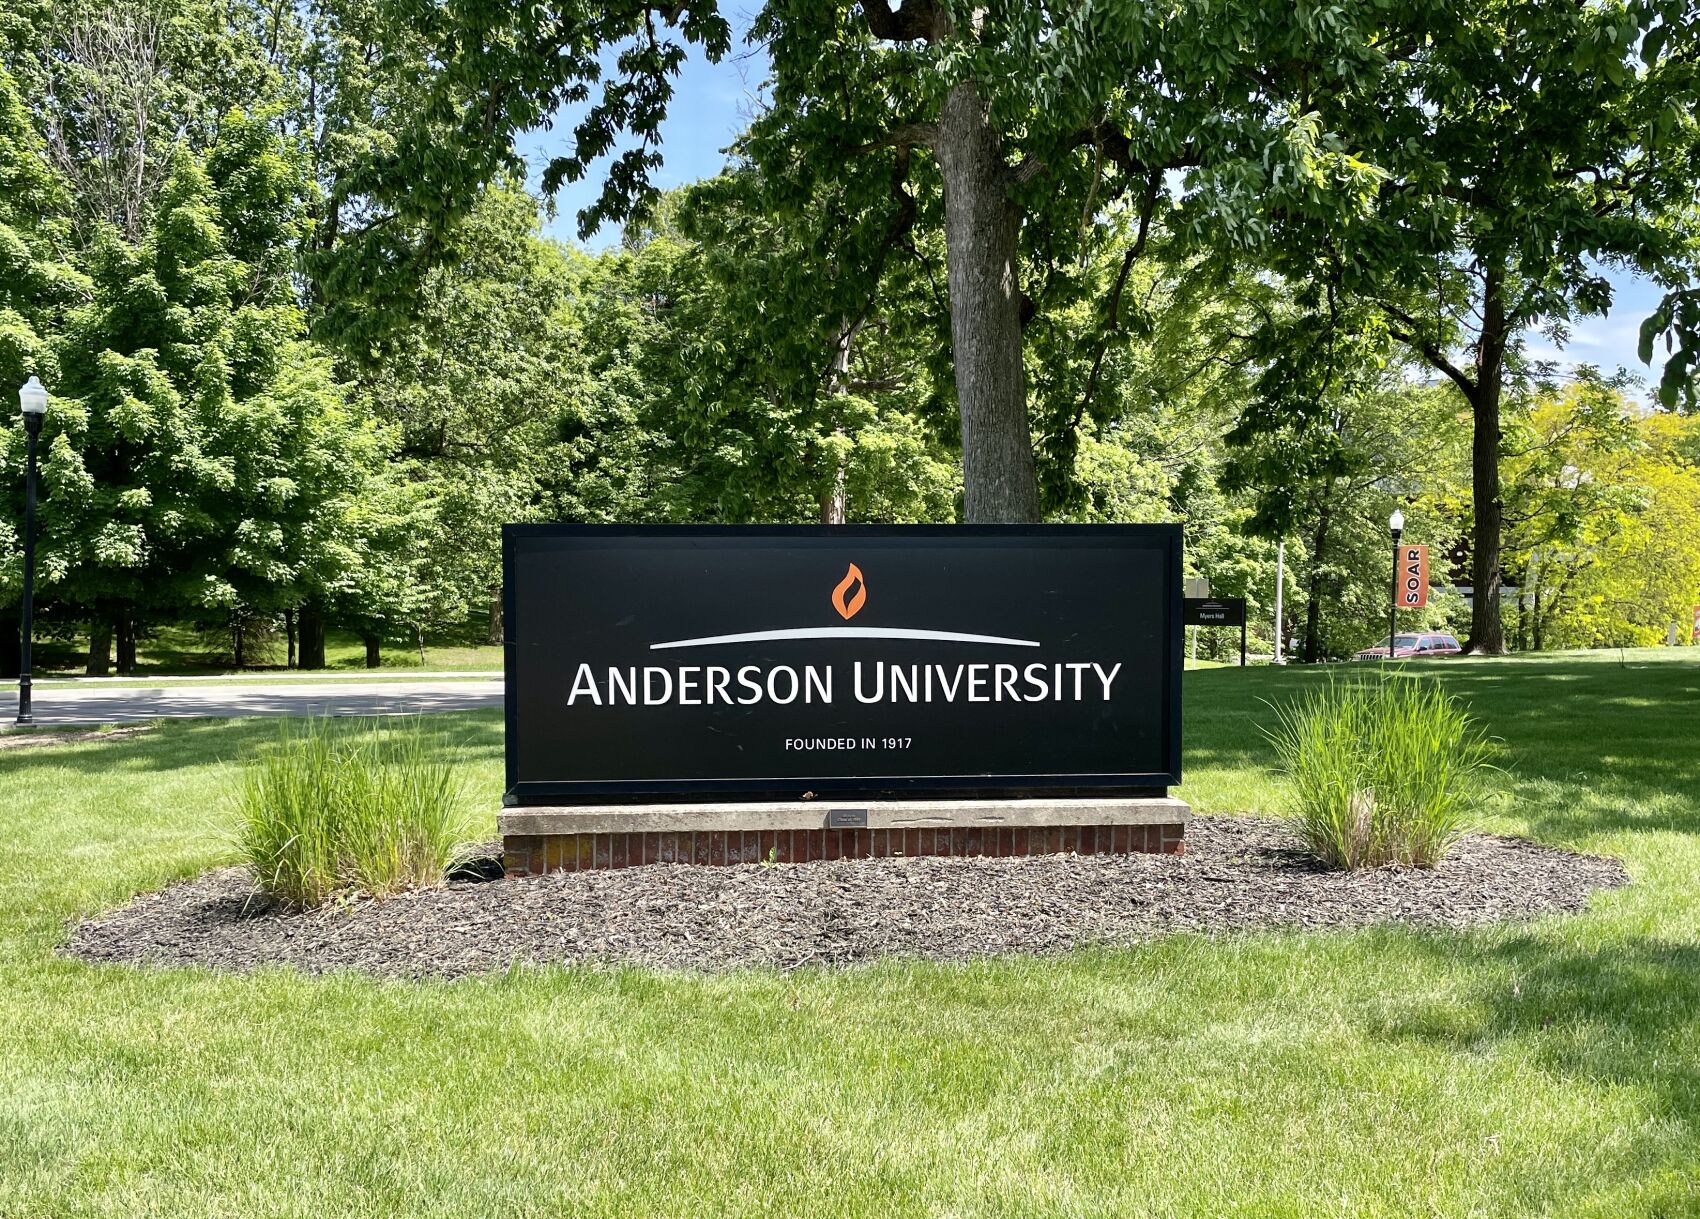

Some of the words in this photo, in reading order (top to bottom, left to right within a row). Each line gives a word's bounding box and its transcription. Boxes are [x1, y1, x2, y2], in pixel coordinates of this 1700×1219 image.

[1407, 549, 1420, 604] SOAR
[1200, 612, 1214, 620] Myers
[566, 663, 833, 706] ANDERSON
[853, 661, 1122, 704] UNIVERSITY
[785, 738, 856, 751] FOUNDED
[861, 737, 876, 750] IN
[881, 737, 912, 749] 1917
